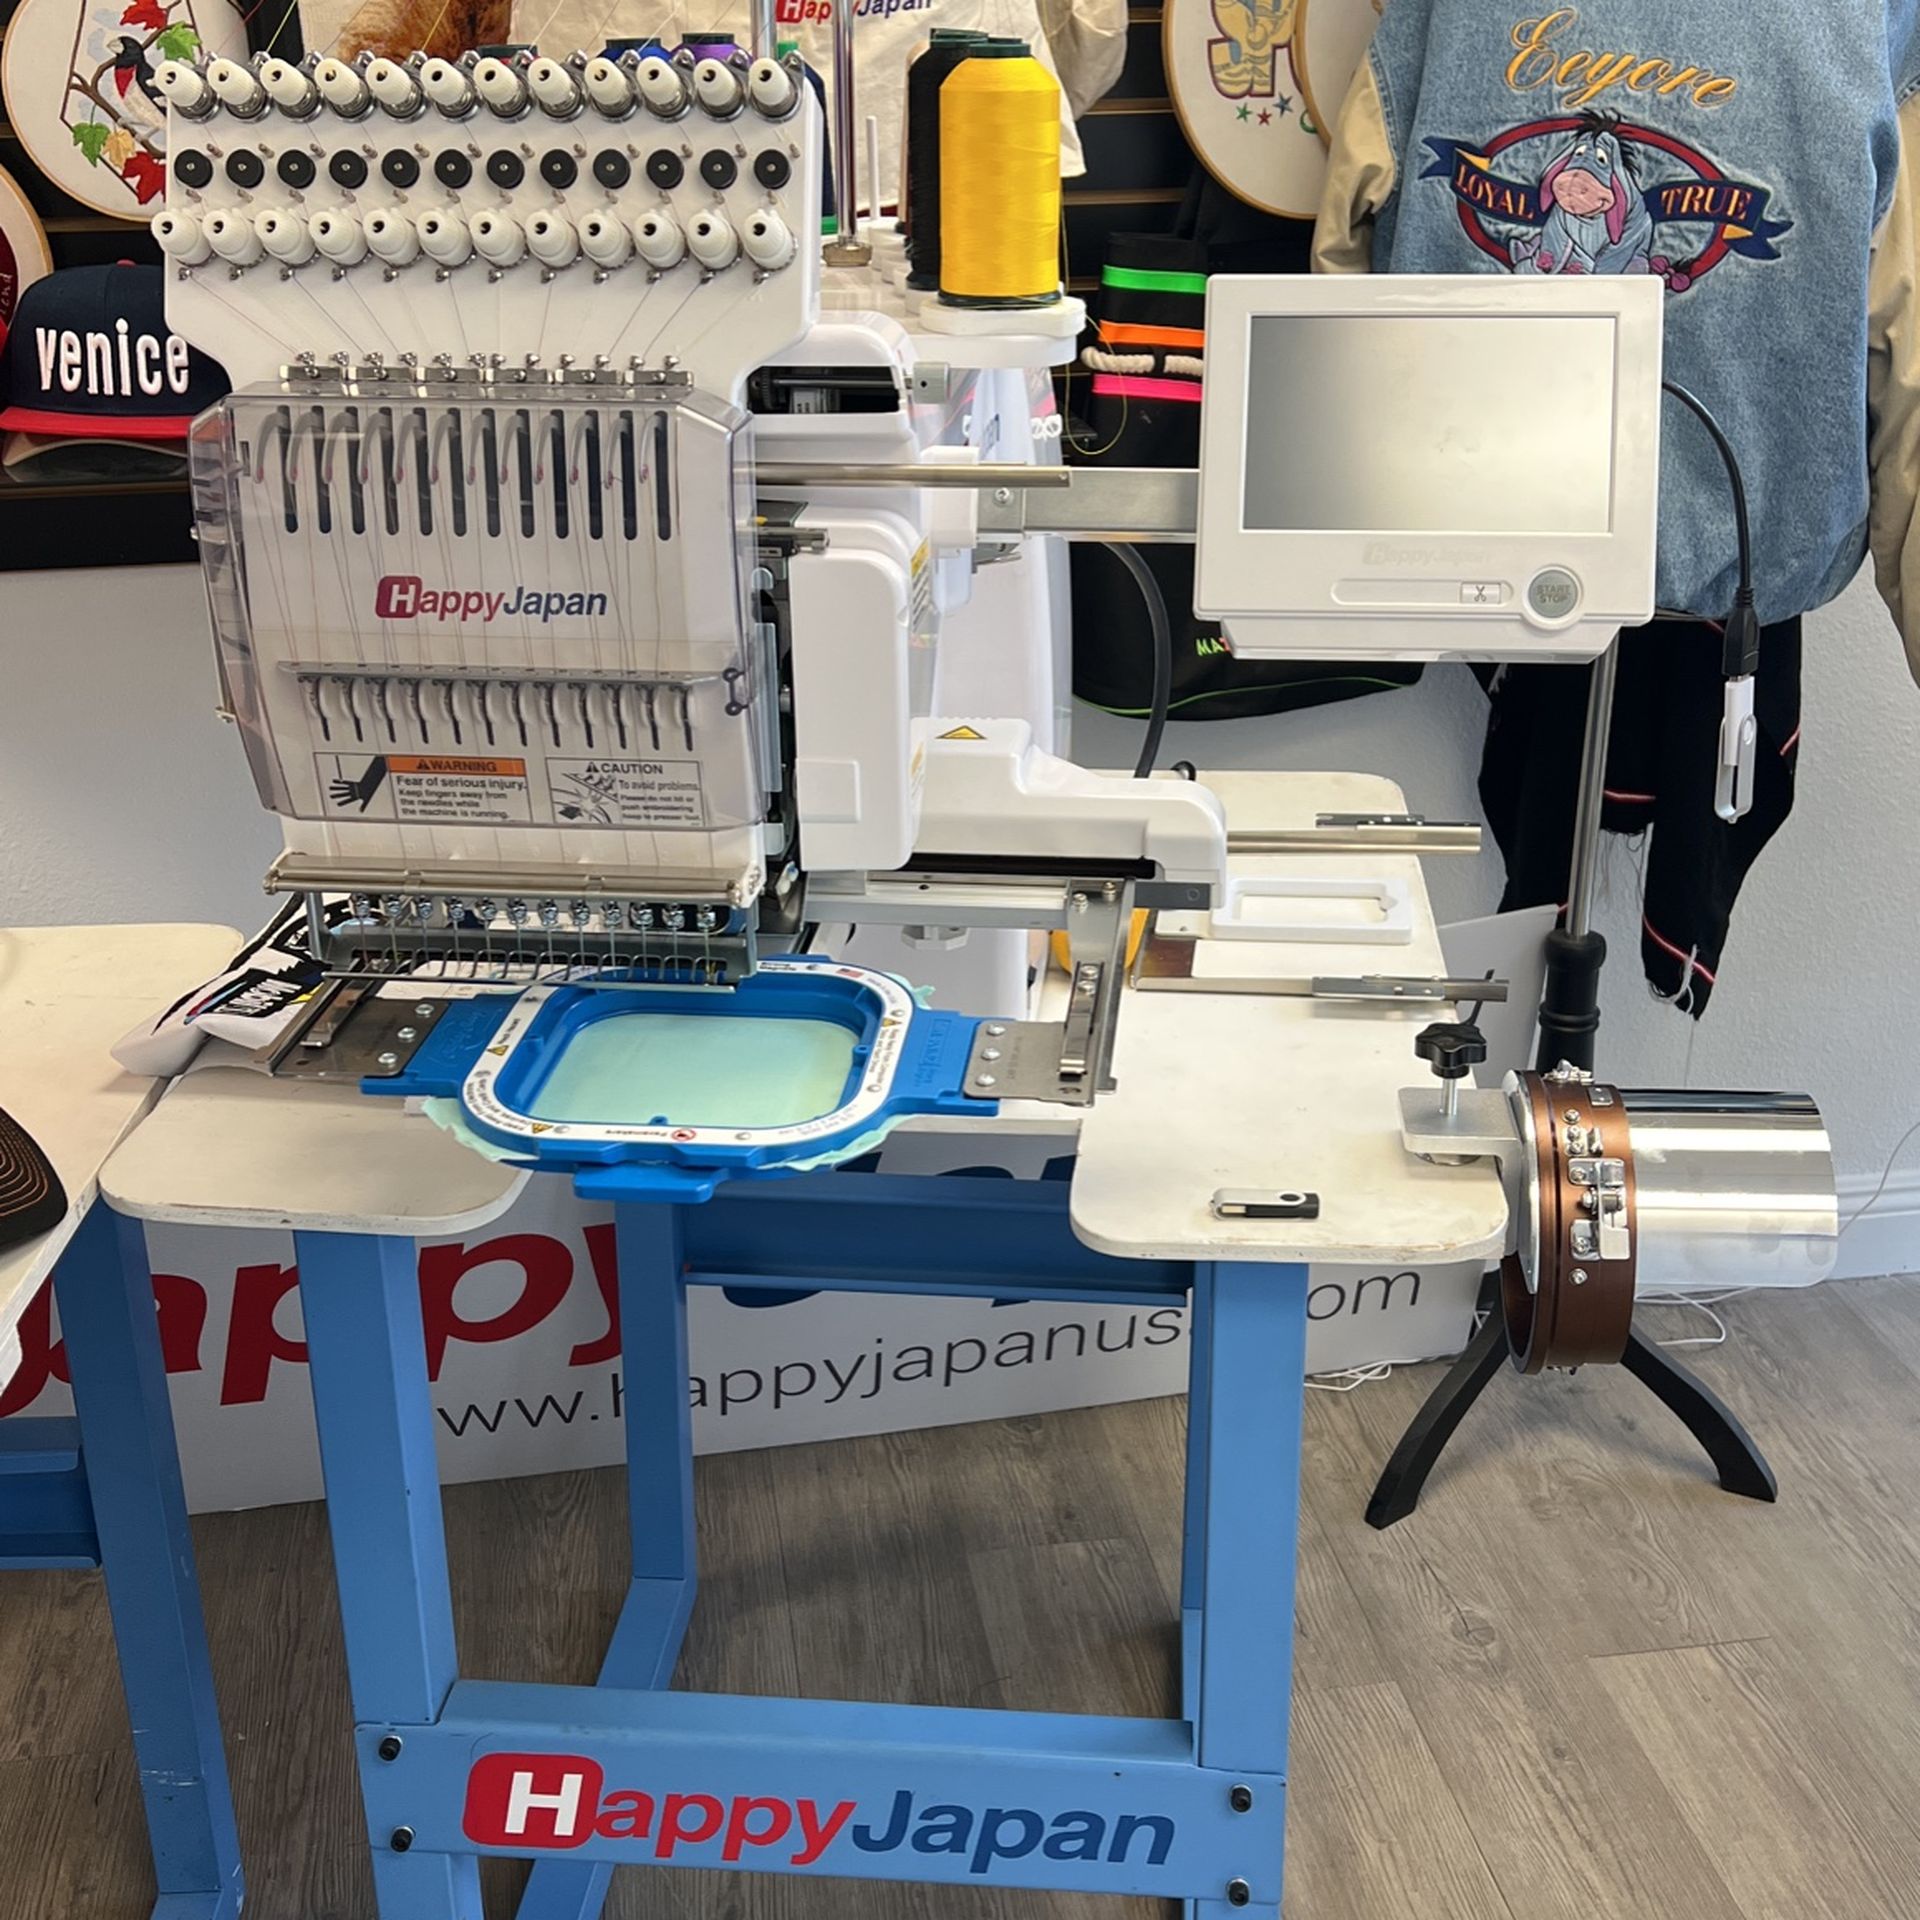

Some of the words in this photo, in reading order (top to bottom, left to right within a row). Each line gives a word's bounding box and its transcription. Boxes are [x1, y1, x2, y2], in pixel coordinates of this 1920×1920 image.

[1505, 7, 1737, 108] Eeyore
[1456, 164, 1535, 219] LOYAL
[1661, 184, 1753, 220] TRUE
[36, 318, 189, 396] venice
[375, 576, 607, 622] HappyJapan
[396, 775, 423, 786] Fear
[426, 777, 438, 786] of
[441, 778, 487, 788] serious
[433, 759, 497, 772] WARNING
[601, 763, 663, 774] CAUTION
[462, 1752, 1176, 1874] HappyJapan
